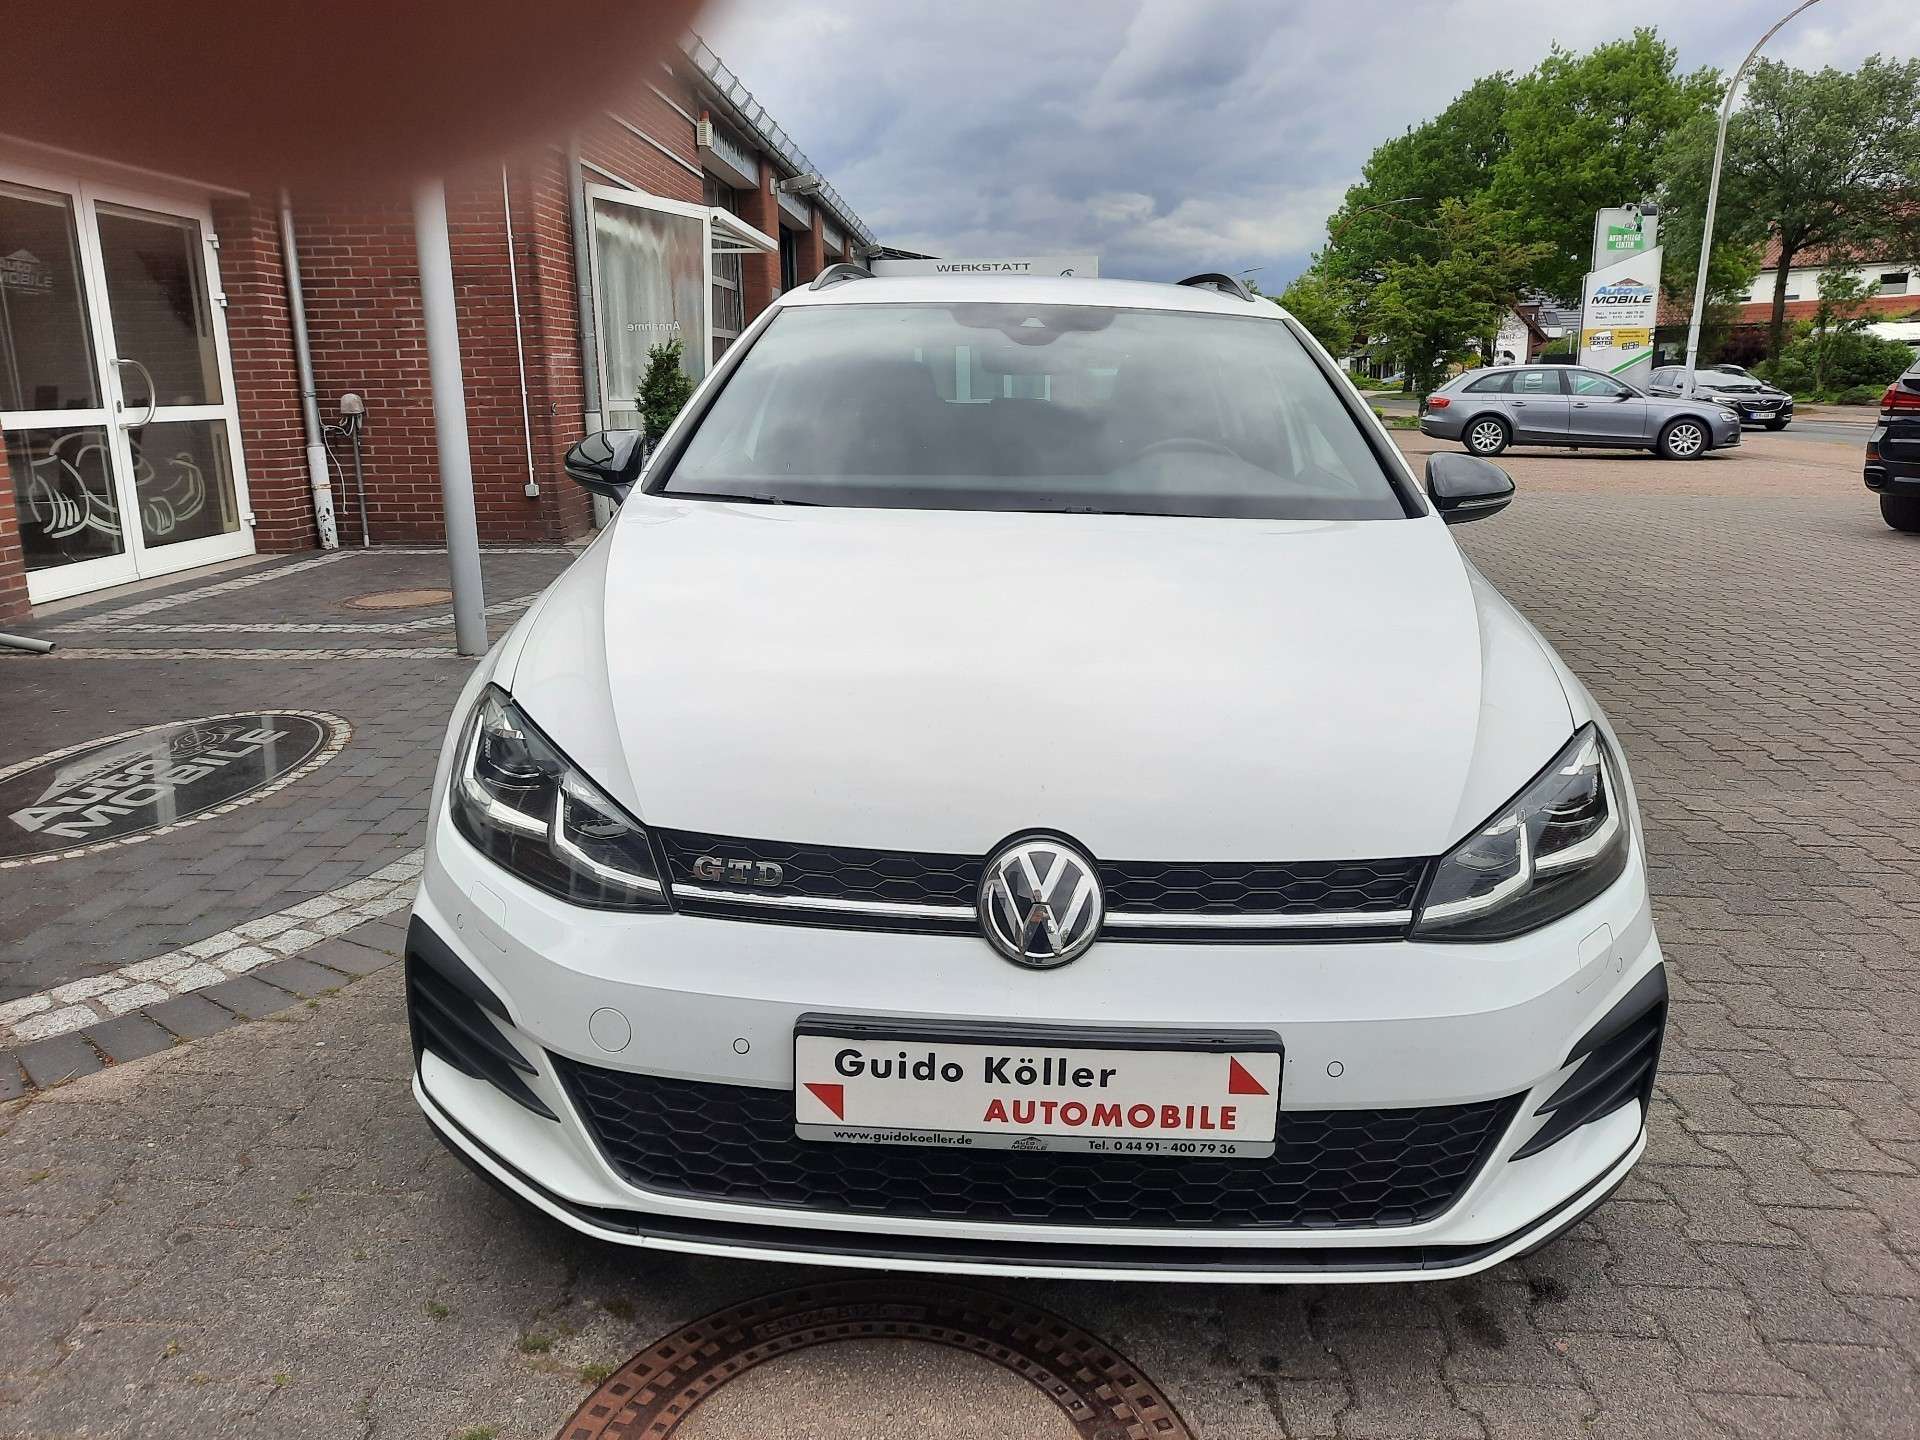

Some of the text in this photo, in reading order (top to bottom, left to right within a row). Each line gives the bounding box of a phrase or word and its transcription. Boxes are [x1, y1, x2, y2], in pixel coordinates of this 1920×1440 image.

[936, 262, 1031, 273] WERKSTATT
[1591, 295, 1653, 305] MOBILE
[42, 728, 290, 839] MOBILE
[693, 855, 784, 888] GTD
[834, 1048, 1117, 1088] Guido Köller
[983, 1098, 1237, 1131] AUTOMOBILE
[833, 1131, 973, 1145] www.guidokoeller.de
[1089, 1140, 1109, 1150] Tel.
[1171, 1143, 1196, 1153] 400
